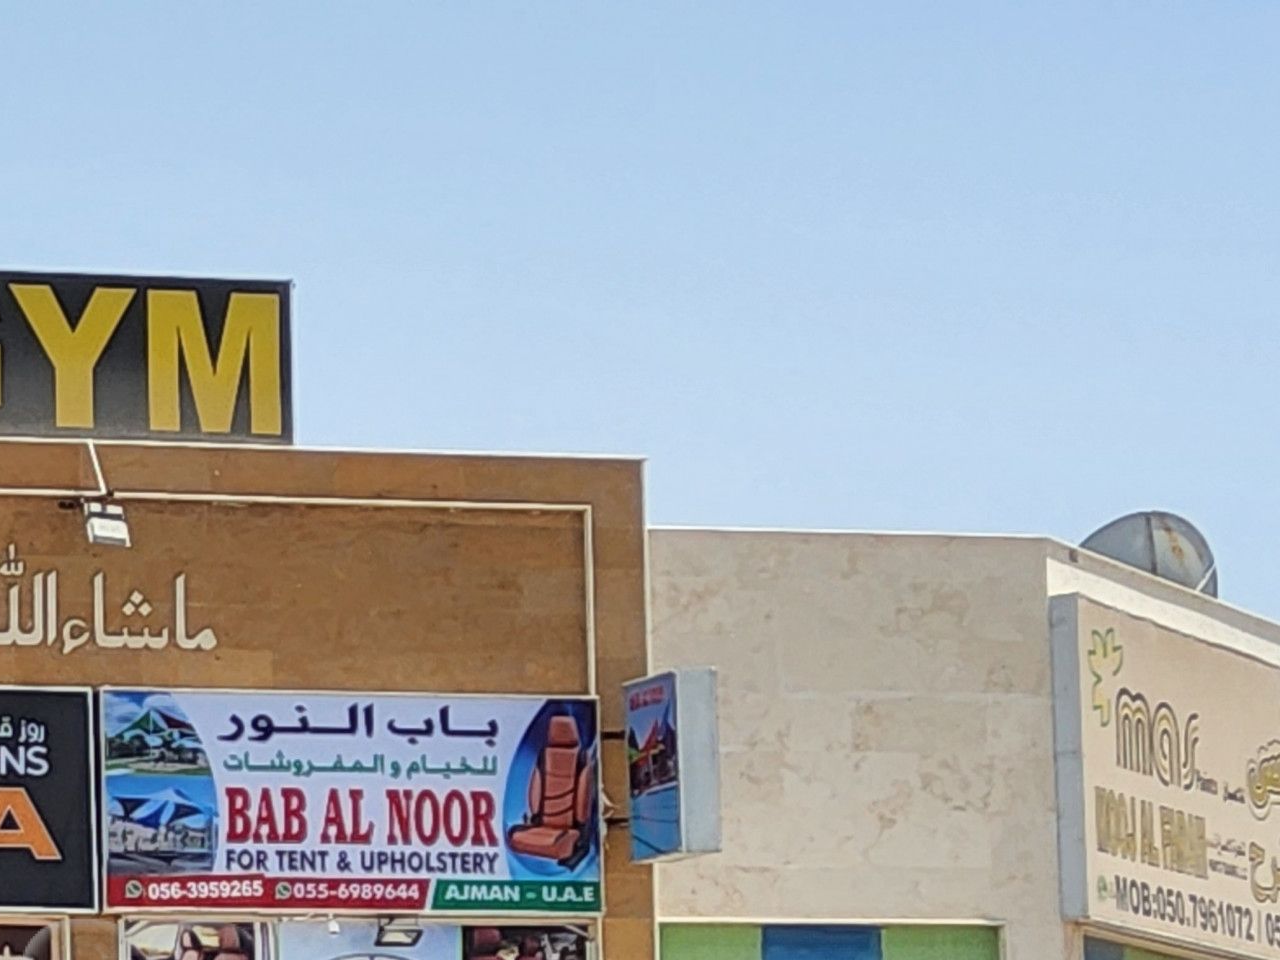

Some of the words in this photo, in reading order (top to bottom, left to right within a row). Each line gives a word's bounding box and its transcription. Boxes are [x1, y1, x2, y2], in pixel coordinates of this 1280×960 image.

[216, 701, 374, 743] النور
[386, 704, 499, 748] باب
[224, 786, 308, 844] BAB
[320, 787, 375, 845] AL
[385, 788, 500, 848] NOOR
[225, 849, 269, 872] FOR
[275, 850, 330, 873] TENT
[336, 851, 352, 873] &
[360, 851, 500, 875] UPHOLSTERY
[147, 879, 264, 900] 056-3959265
[293, 882, 420, 900] 055-6989644
[444, 883, 520, 901] AJMAN
